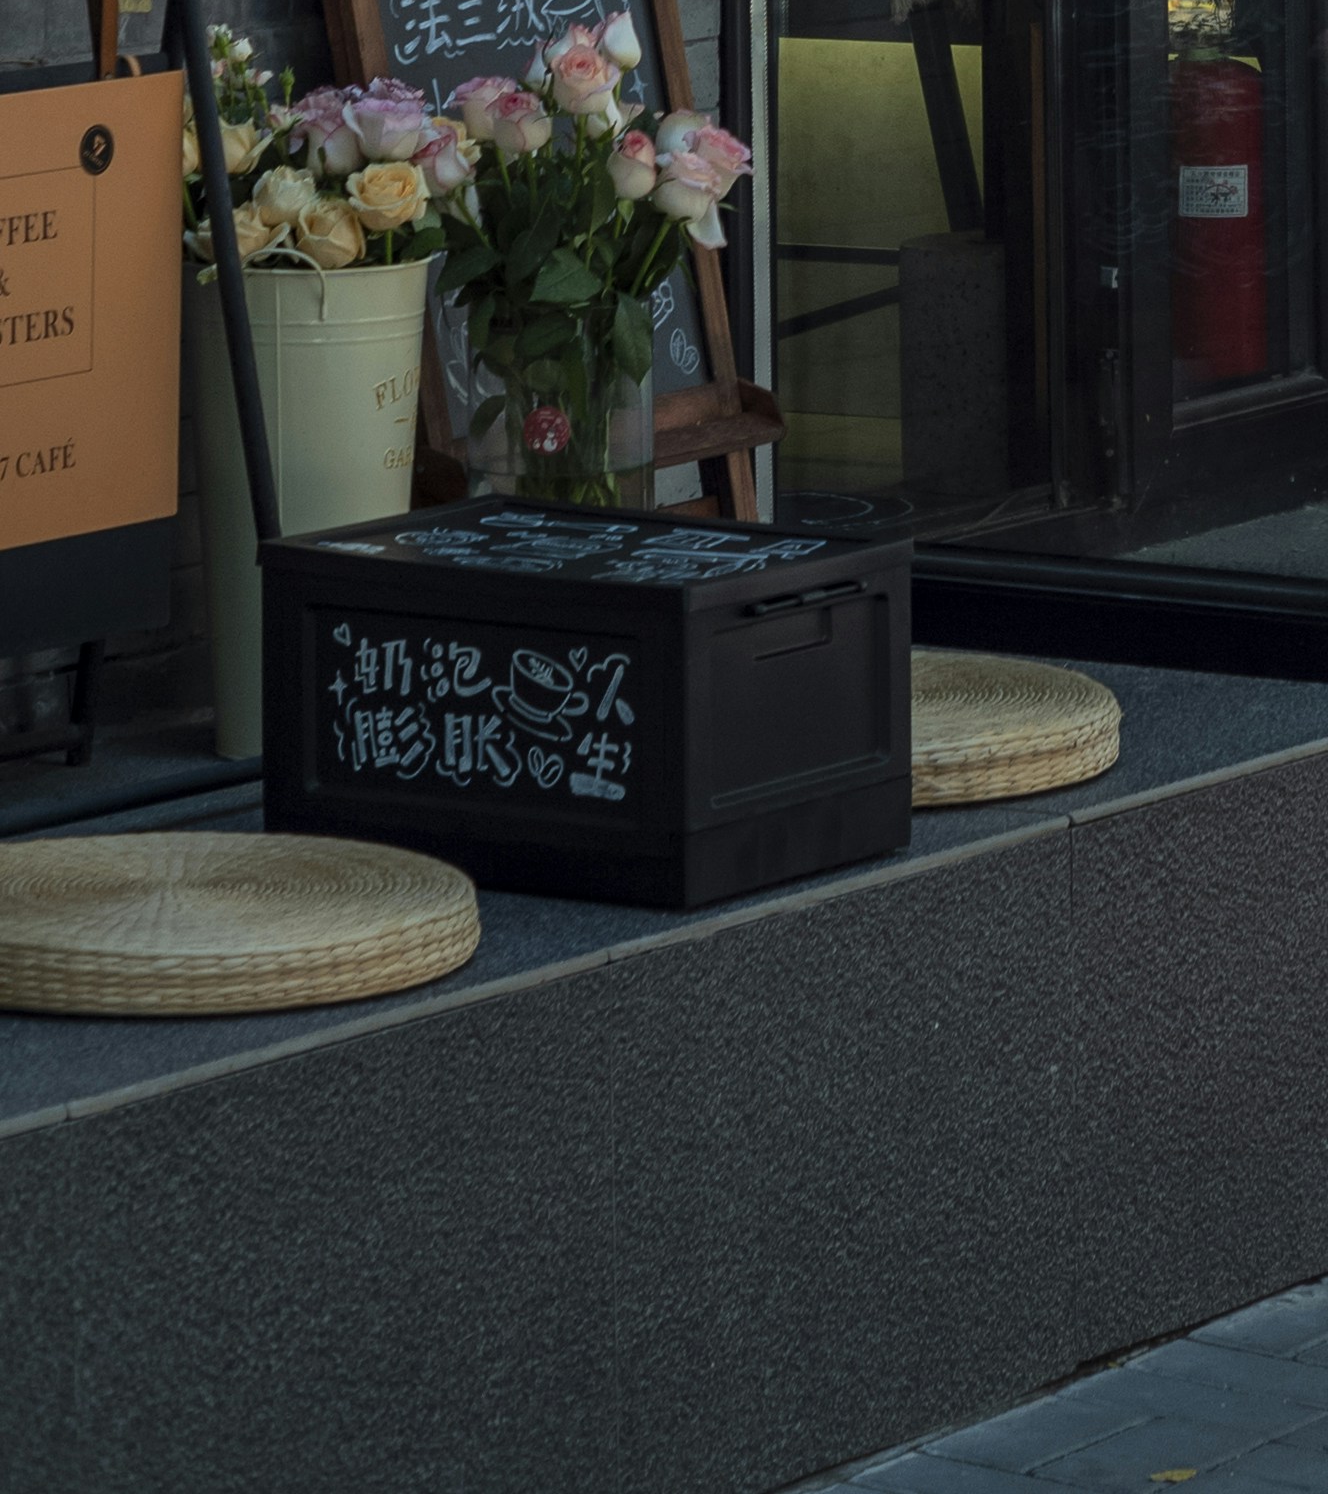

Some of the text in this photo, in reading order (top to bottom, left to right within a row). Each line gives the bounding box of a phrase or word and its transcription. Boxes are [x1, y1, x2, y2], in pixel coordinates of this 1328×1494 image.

[0, 306, 76, 347] TERS
[16, 435, 77, 479] CAFÉ
[355, 638, 493, 698] 奶泡
[353, 704, 513, 776] 膨胀
